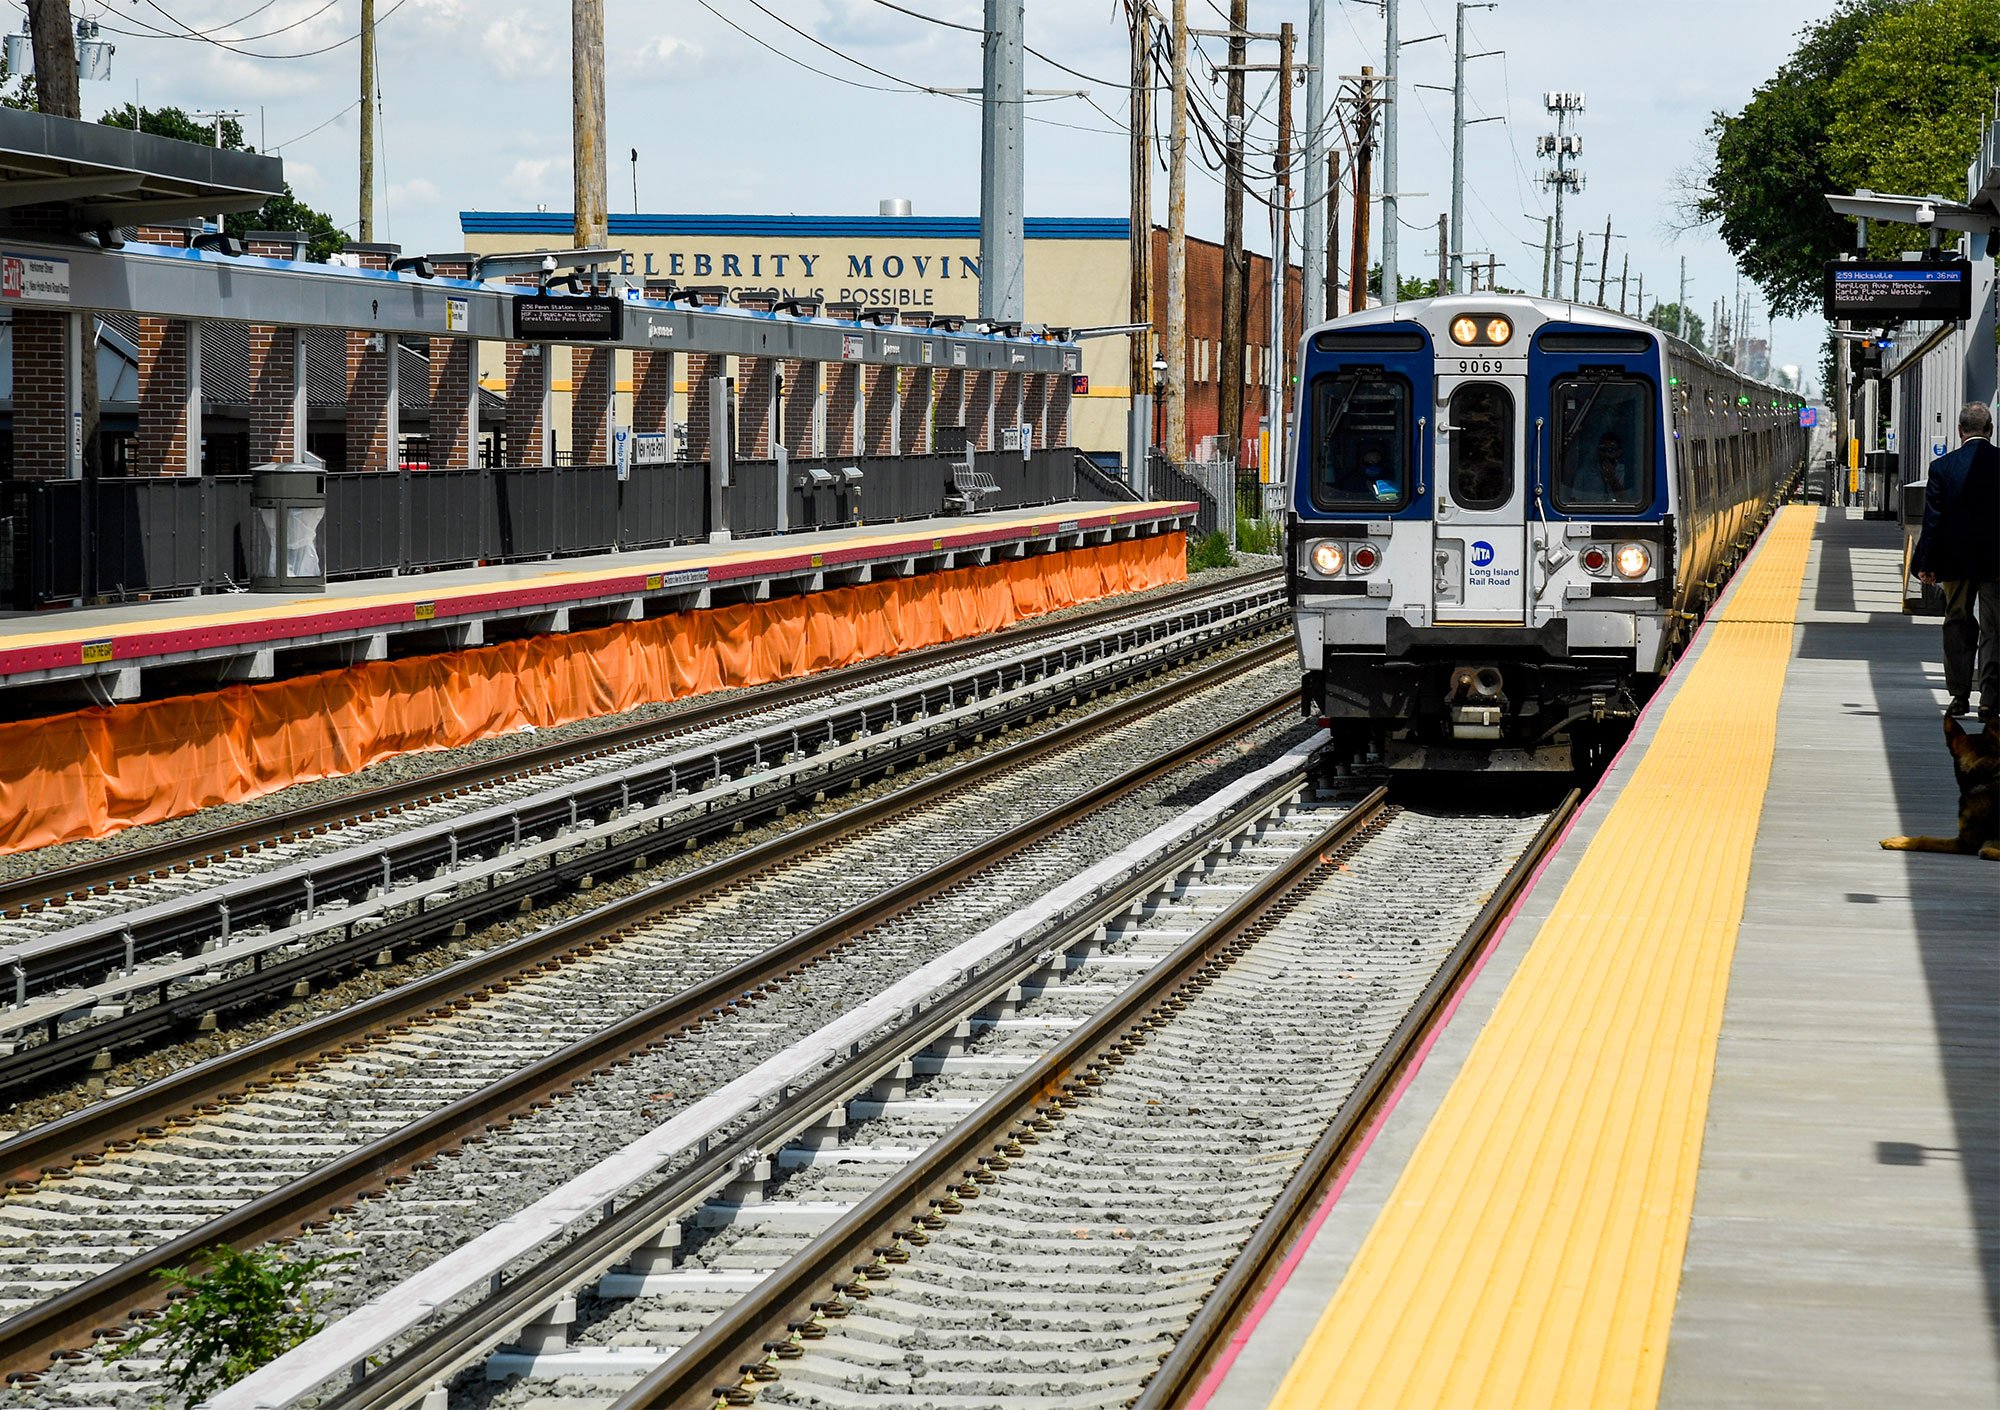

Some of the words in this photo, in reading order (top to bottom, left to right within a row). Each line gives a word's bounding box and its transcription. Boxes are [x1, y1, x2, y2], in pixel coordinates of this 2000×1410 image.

[607, 252, 820, 278] ELEBRITY
[3, 258, 21, 291] Exit
[1836, 272, 1853, 280] 2:59
[1854, 272, 1894, 280] Hicksville
[1925, 272, 1934, 280] in
[841, 288, 934, 306] POSSIBLE
[1459, 360, 1503, 373] 9069
[1471, 545, 1491, 562] MTA
[1469, 567, 1491, 577] Long
[1493, 567, 1520, 576] Island
[1469, 577, 1486, 586] Rail
[1488, 577, 1511, 586] Road
